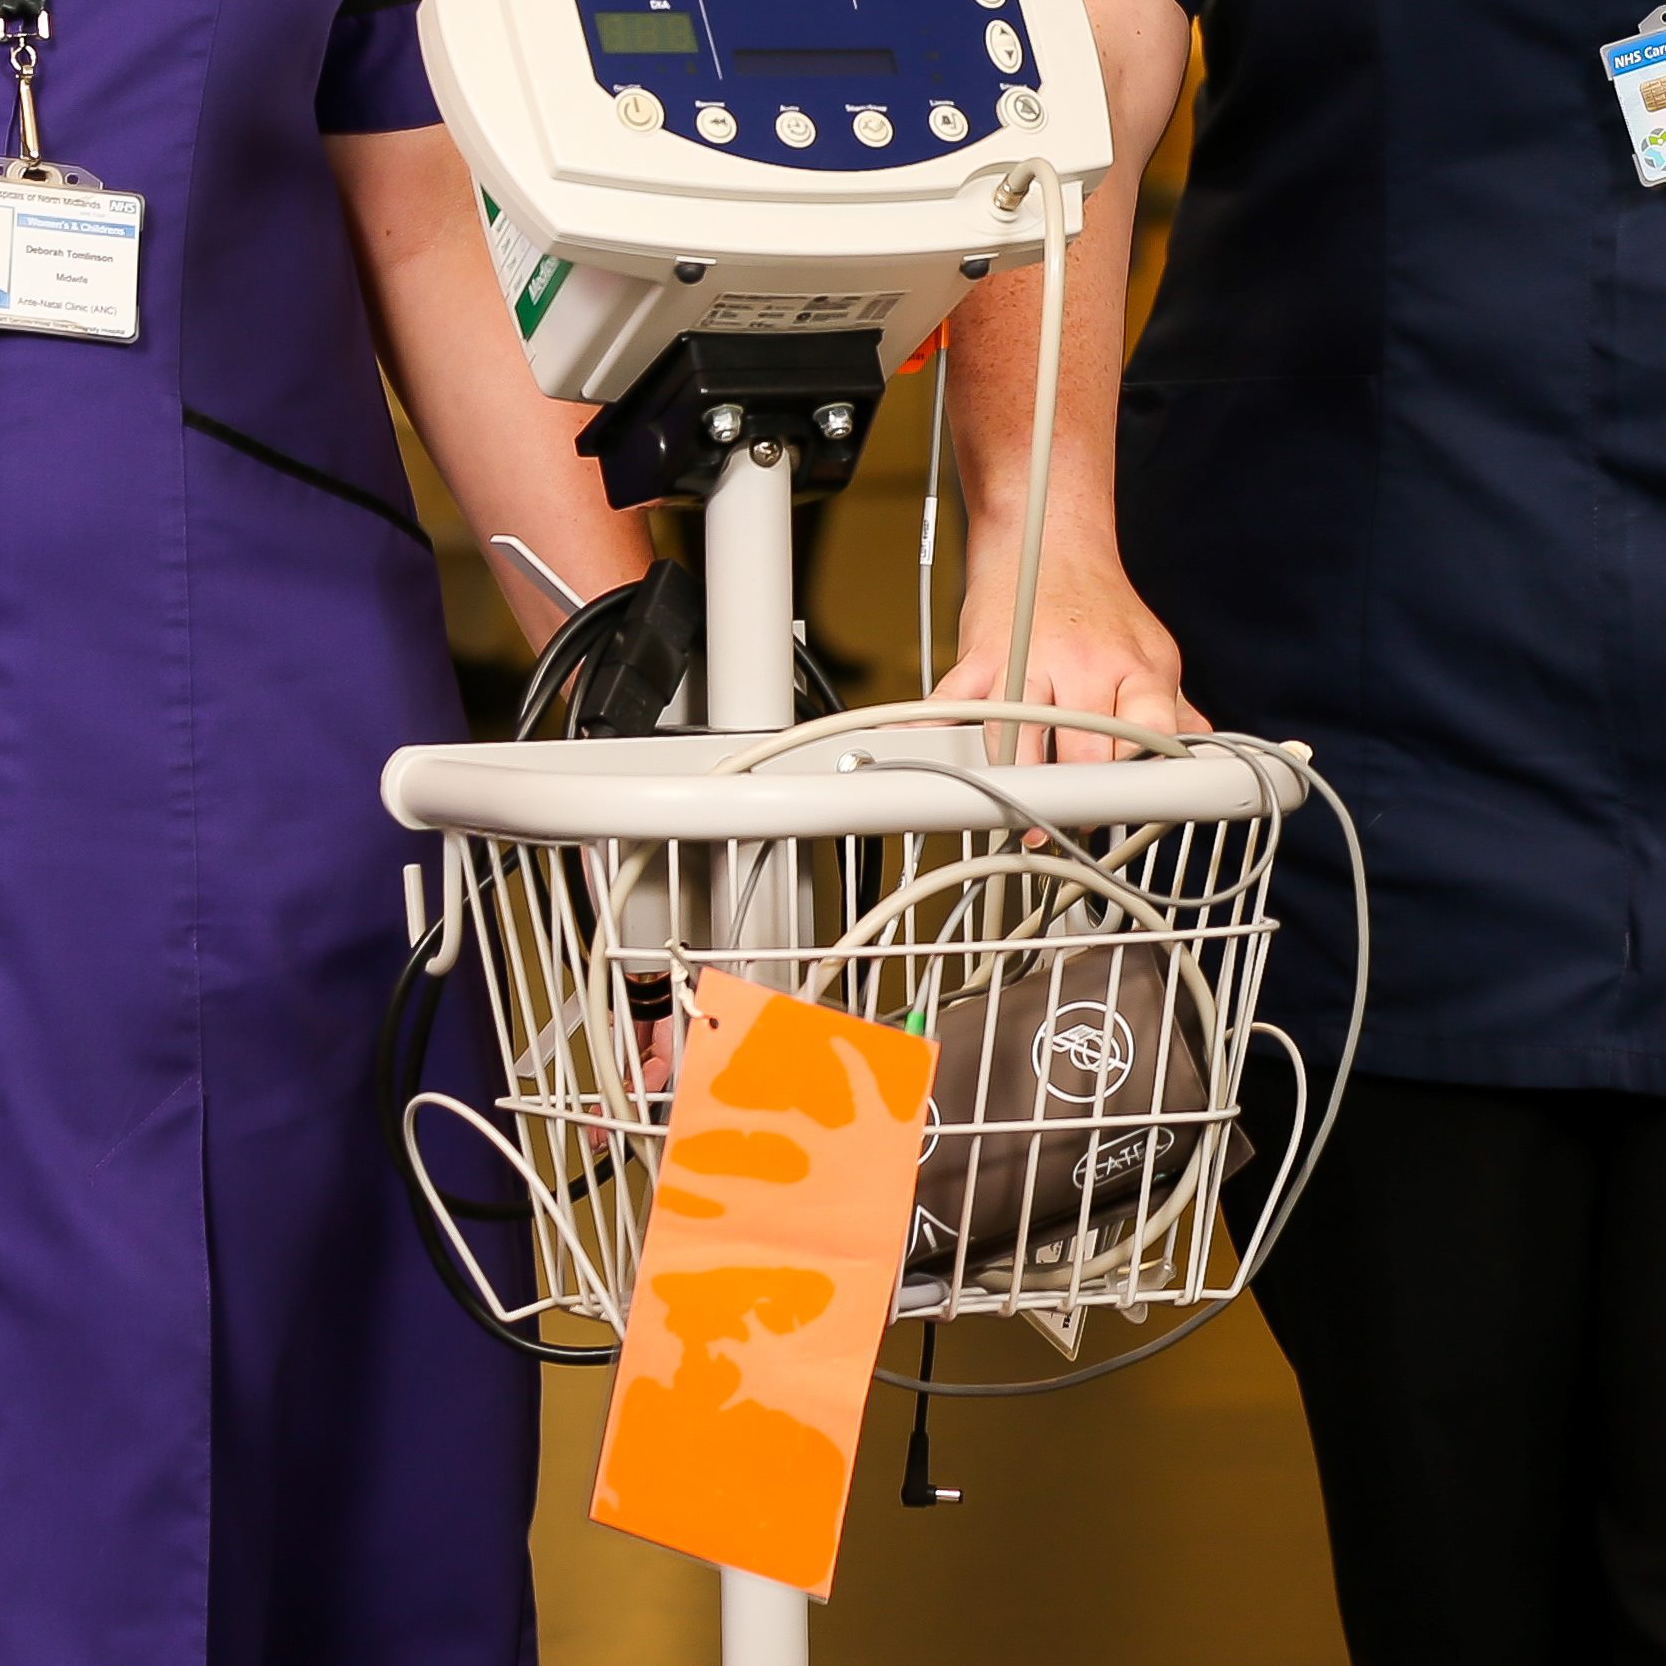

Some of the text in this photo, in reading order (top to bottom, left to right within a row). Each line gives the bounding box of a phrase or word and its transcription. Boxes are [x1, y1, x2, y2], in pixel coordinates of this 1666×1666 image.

[1614, 51, 1642, 69] NHS
[110, 200, 137, 213] NHS
[25, 244, 114, 263] Deborah Tomlinson
[90, 305, 118, 317] (ANC)
